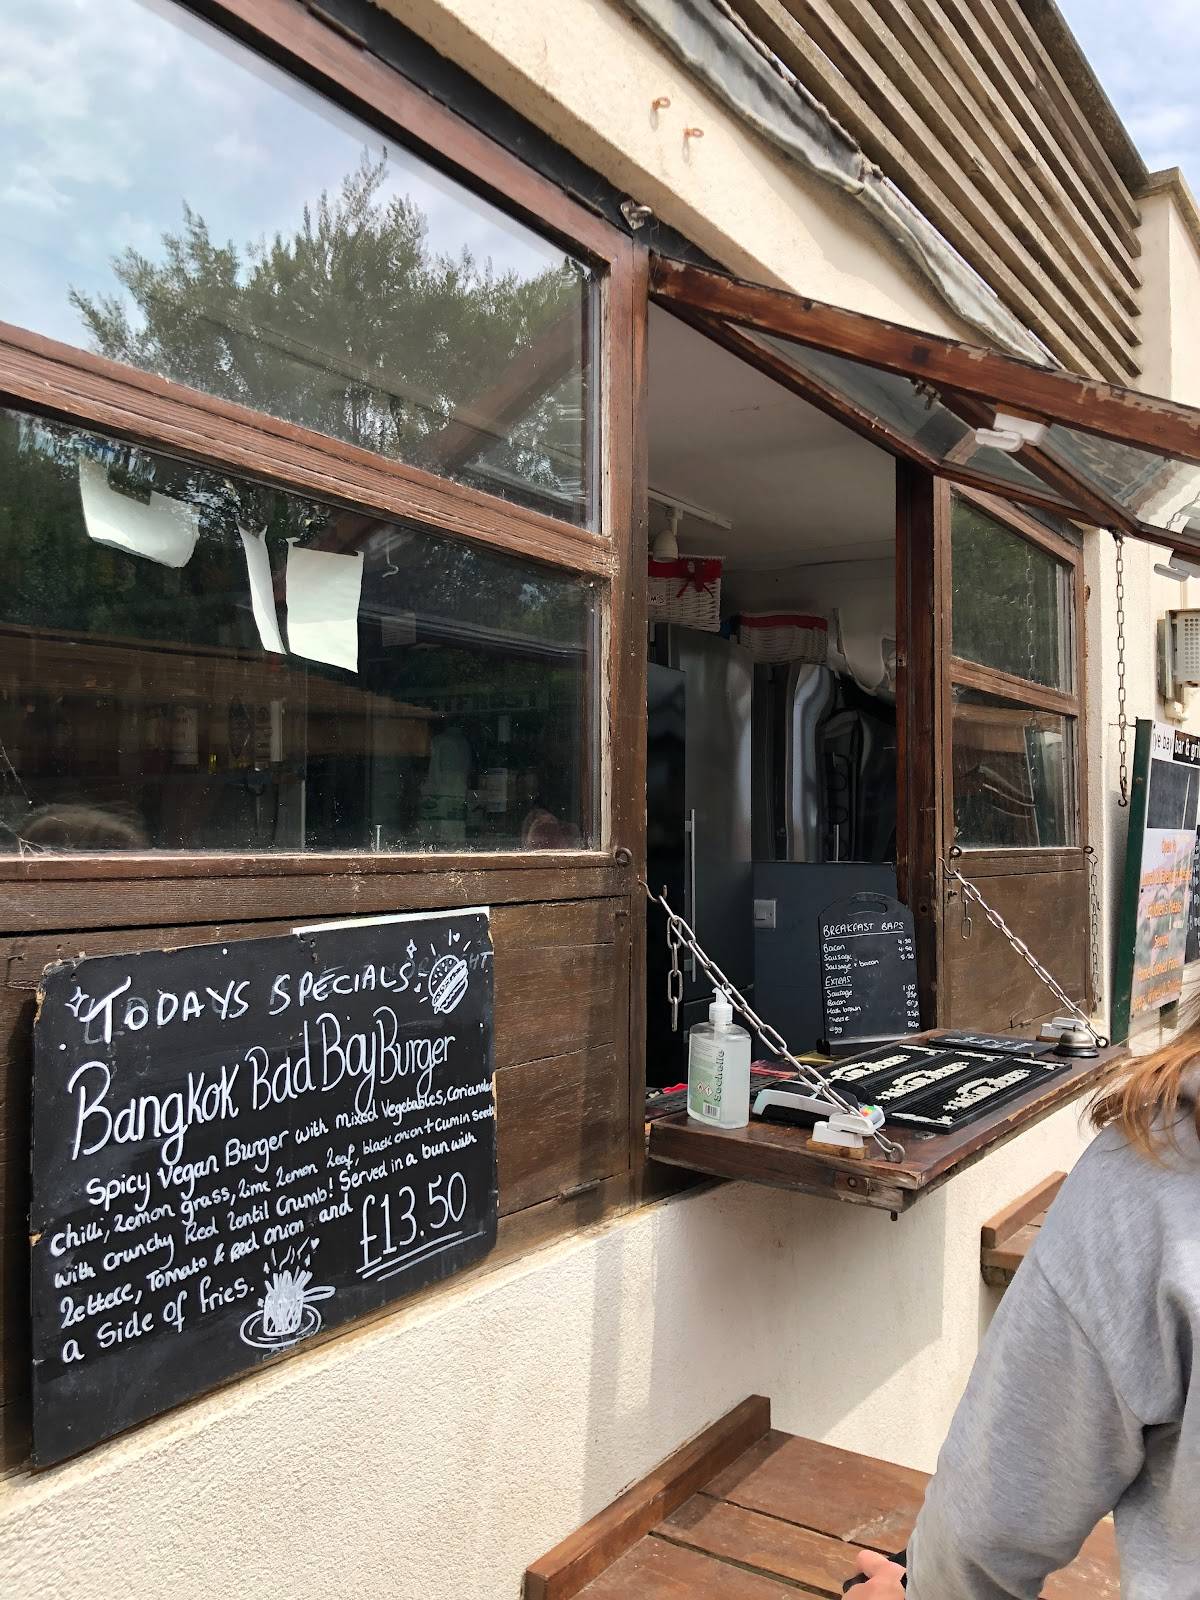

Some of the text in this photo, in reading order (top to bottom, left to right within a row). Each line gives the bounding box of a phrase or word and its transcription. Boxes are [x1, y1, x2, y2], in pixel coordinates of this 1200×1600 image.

[1174, 735, 1184, 754] bar
[823, 921, 904, 937] BREAKFAST BAPS
[823, 943, 845, 953] Bacon
[824, 953, 853, 962] Sausage
[825, 962, 852, 974] Sausage
[859, 959, 879, 967] bacon
[79, 963, 413, 1044] TODAYS SPECIALS
[826, 990, 853, 998] Sausage
[827, 999, 847, 1007] Bacon
[245, 1020, 316, 1111] Bad
[315, 1012, 376, 1115] Boy
[373, 1005, 456, 1100] Burger
[86, 1172, 150, 1211] Spicy
[225, 1130, 289, 1173] Burger
[295, 1117, 329, 1144] with
[181, 1187, 236, 1226] grass,
[363, 1135, 393, 1155] black
[54, 1261, 96, 1289] with
[184, 1216, 219, 1245] Red
[276, 1177, 334, 1217] Crumb!
[339, 1159, 389, 1192] Served
[391, 1157, 404, 1173] in
[405, 1152, 418, 1167] a
[421, 1141, 450, 1160] bun
[450, 1131, 478, 1152] with
[356, 1171, 467, 1273] £13.50
[146, 1256, 207, 1292] Tomato
[230, 1231, 260, 1263] Red
[318, 1192, 354, 1223] and
[62, 1339, 86, 1364] a
[97, 1311, 155, 1349] Side
